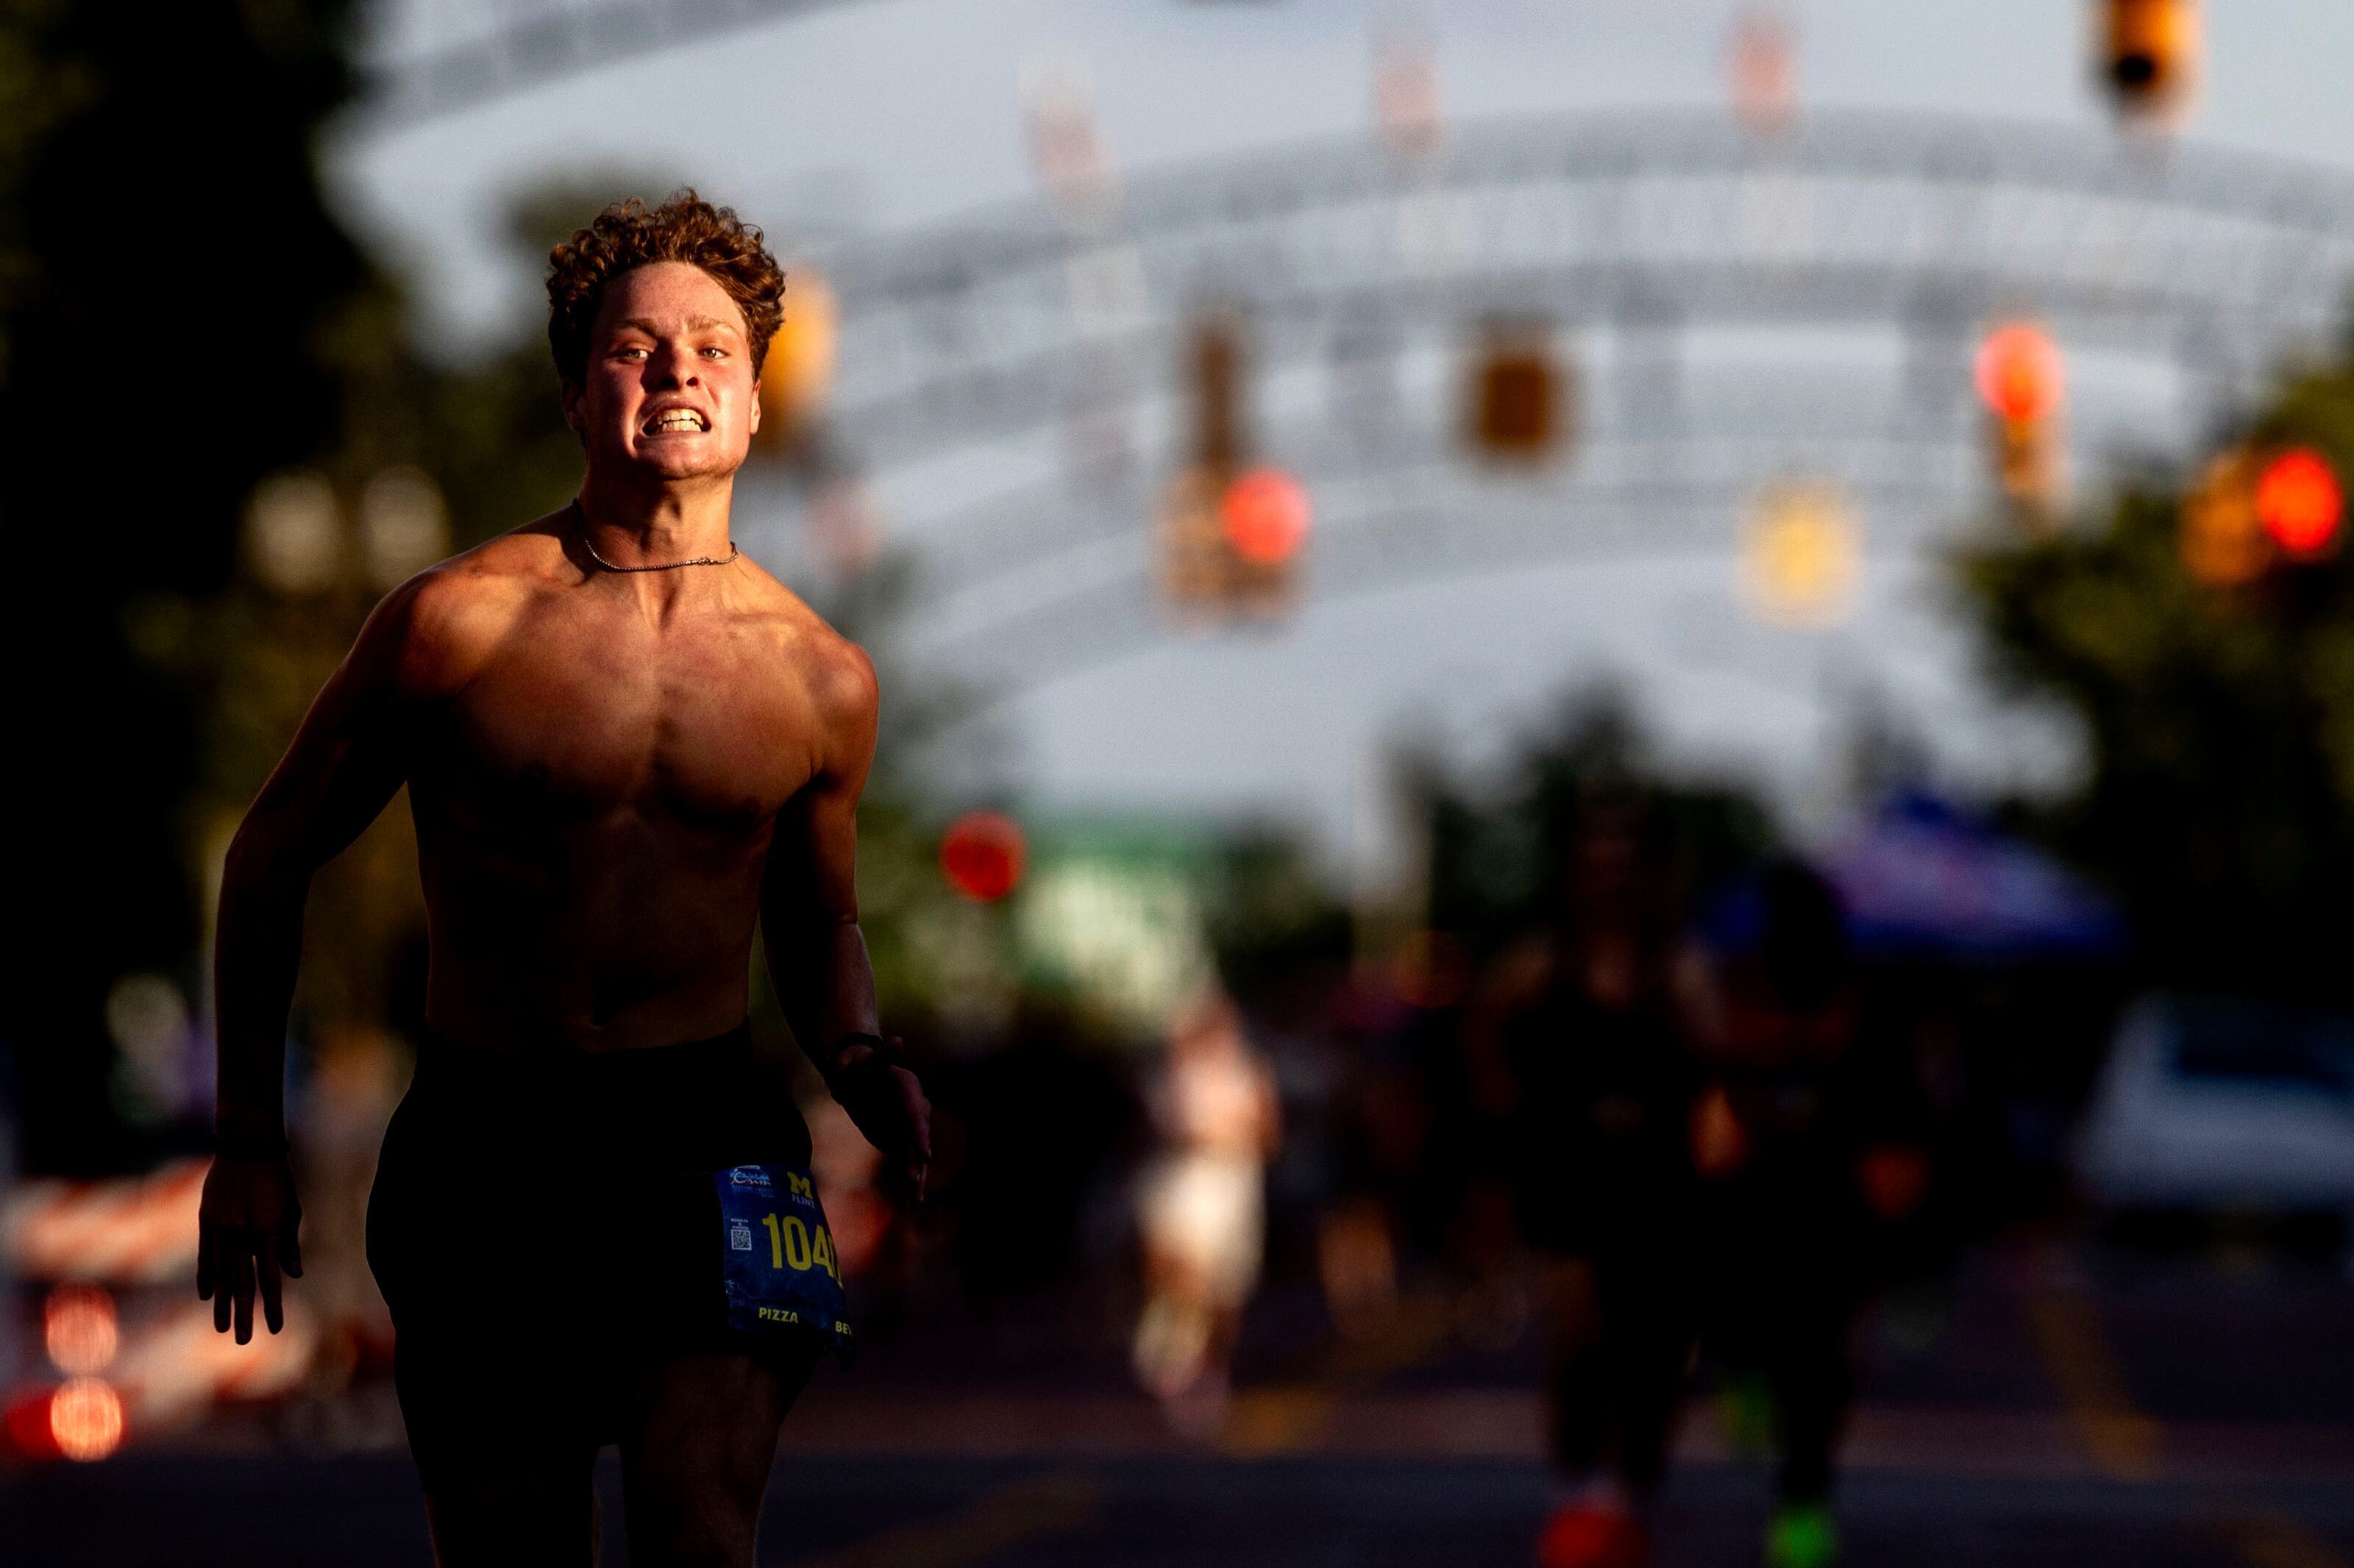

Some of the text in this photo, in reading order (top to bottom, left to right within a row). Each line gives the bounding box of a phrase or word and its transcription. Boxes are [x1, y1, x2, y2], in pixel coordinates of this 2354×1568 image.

[786, 1170, 814, 1200] M
[791, 1193, 816, 1209] FLINT
[758, 1306, 799, 1325] PIZZA
[835, 1319, 854, 1338] BEV
